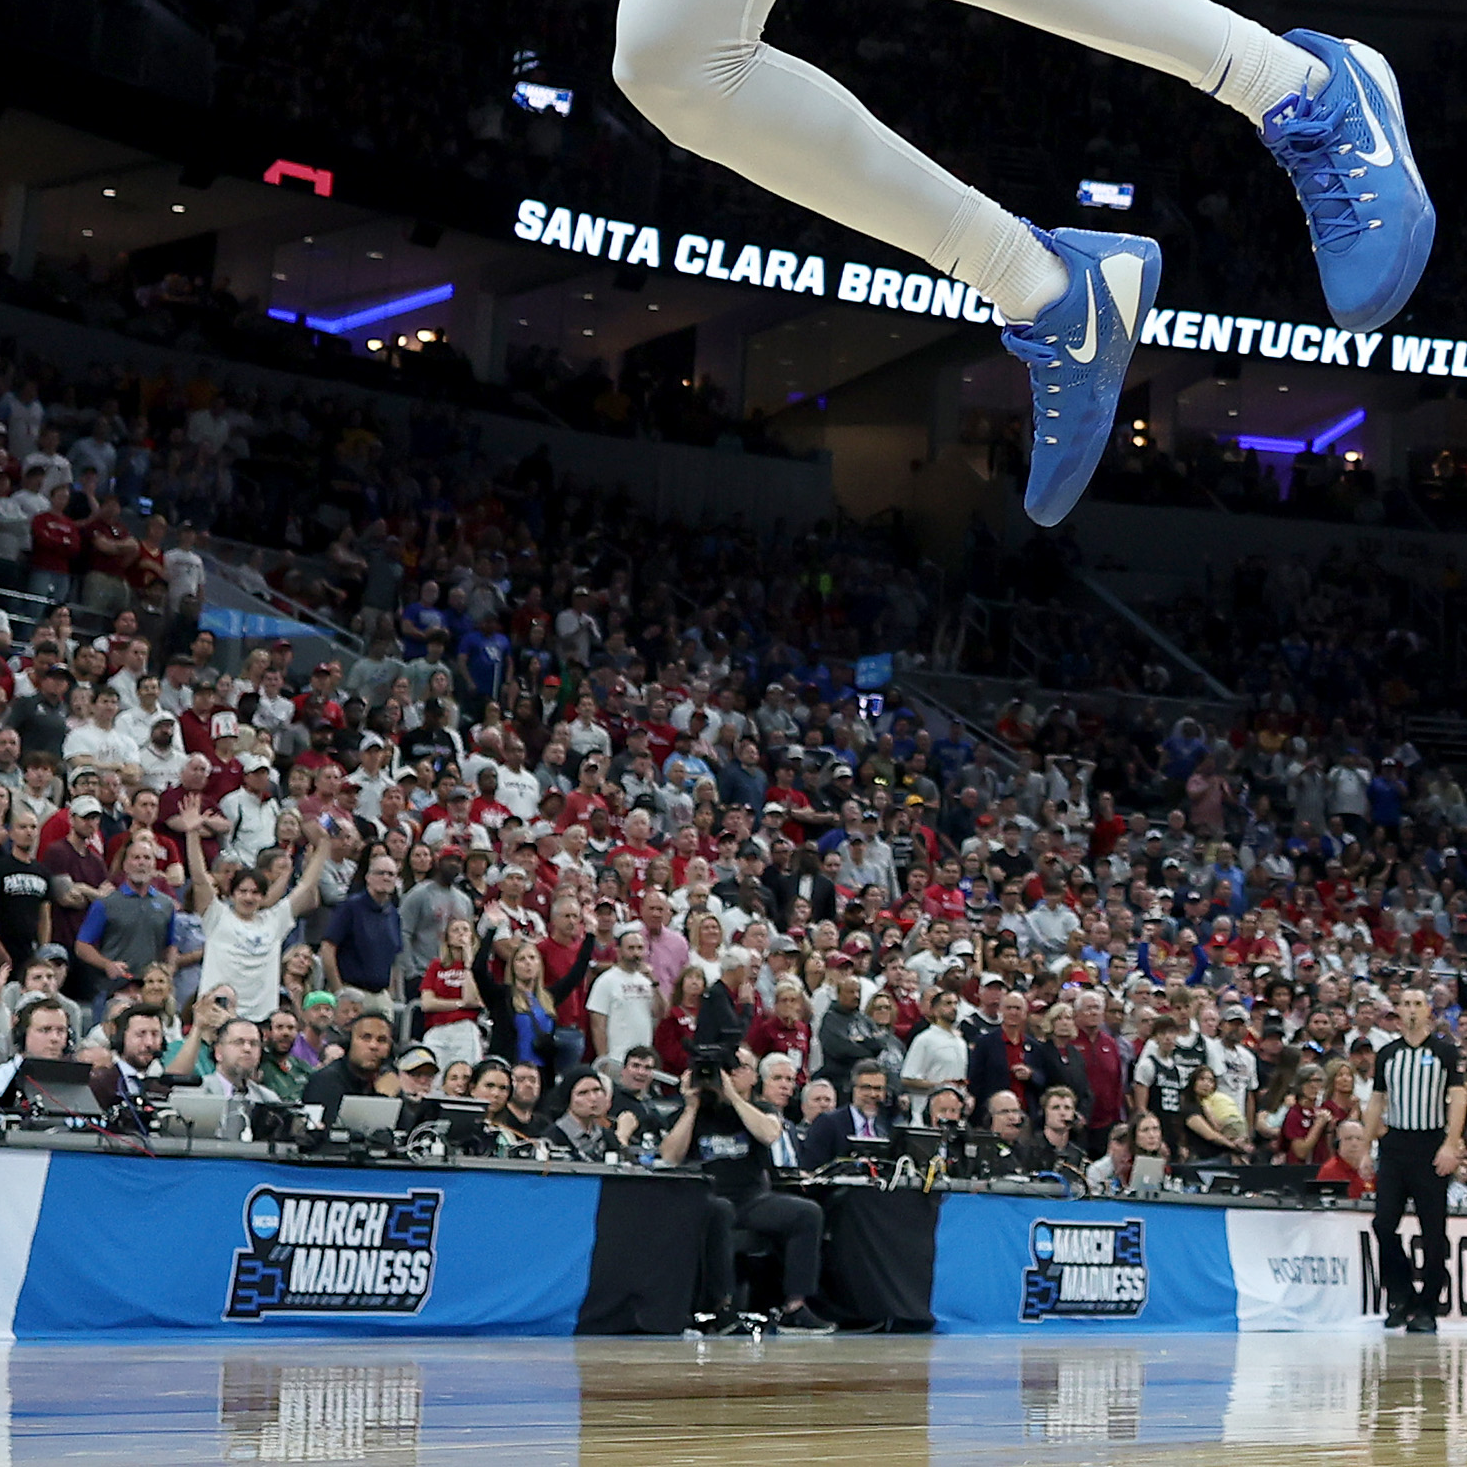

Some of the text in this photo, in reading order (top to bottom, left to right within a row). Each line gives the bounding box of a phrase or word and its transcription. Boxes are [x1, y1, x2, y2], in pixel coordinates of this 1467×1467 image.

[514, 198, 660, 268] SANTA
[674, 234, 825, 297] CLARA
[1140, 307, 1383, 368] KENTUCKY
[277, 1197, 390, 1248] MARCH
[1052, 1227, 1115, 1264] MARCH
[288, 1247, 432, 1295] MADNESS
[1059, 1264, 1147, 1302] MADNESS
[1268, 1256, 1351, 1286] HOSTED BY
